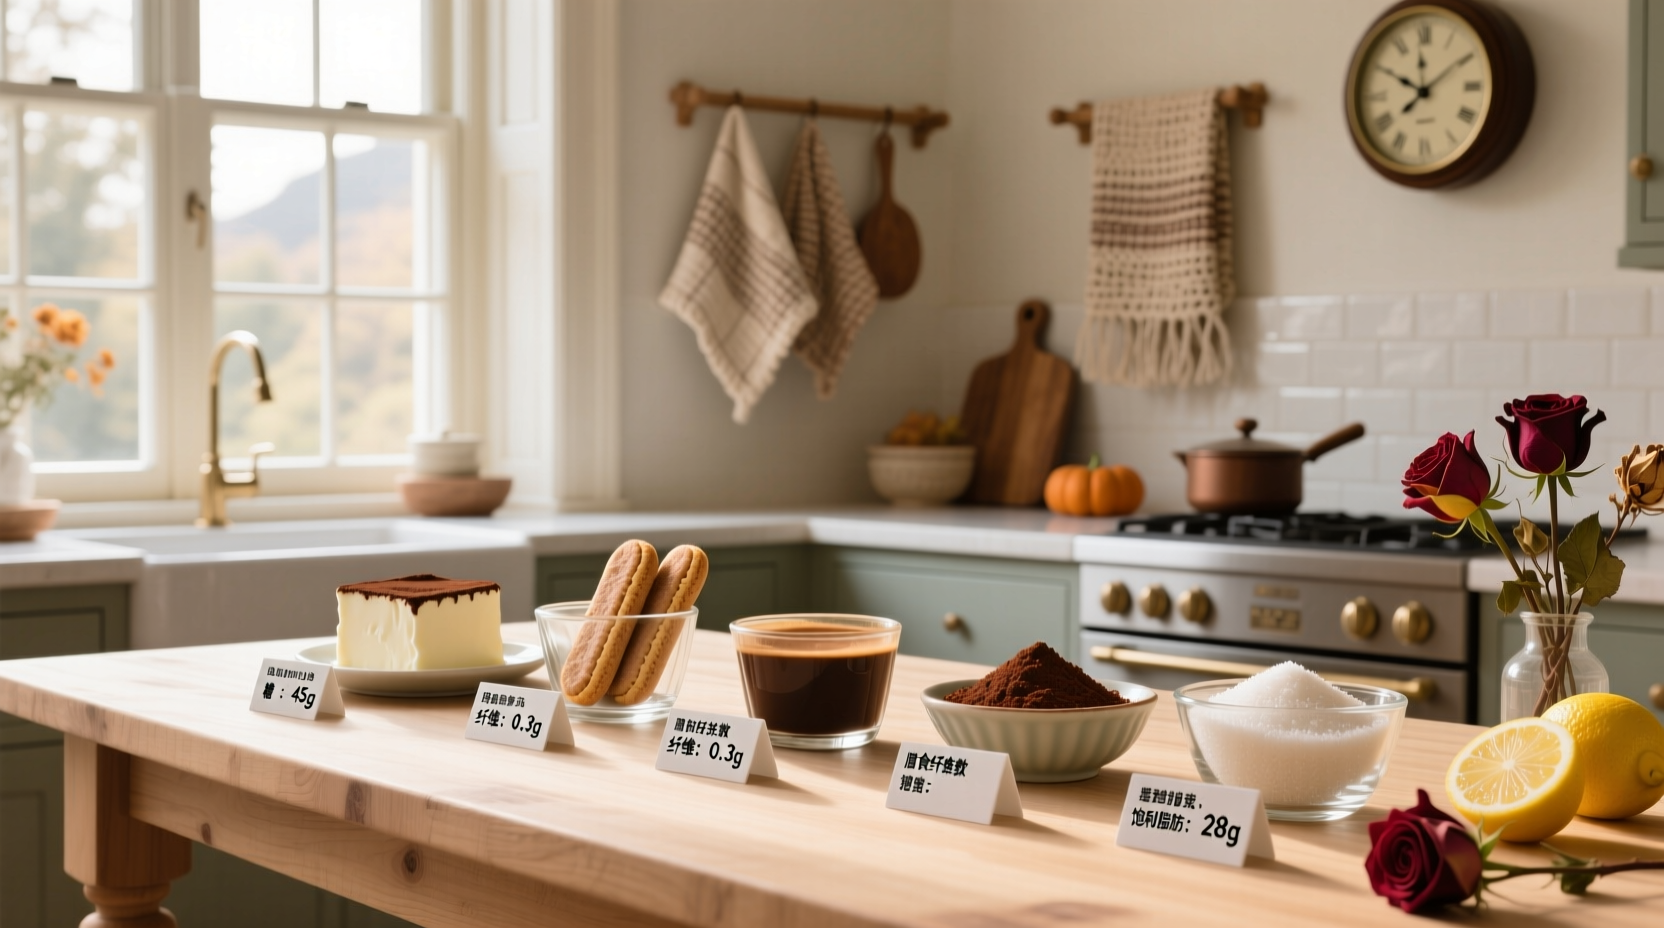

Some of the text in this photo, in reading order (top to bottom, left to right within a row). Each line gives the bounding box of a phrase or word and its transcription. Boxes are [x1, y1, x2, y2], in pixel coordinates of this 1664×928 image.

[291, 686, 316, 709] 45g
[512, 713, 543, 738] 0.3g
[709, 742, 744, 769] 0.3g
[1201, 814, 1242, 848] 28g
